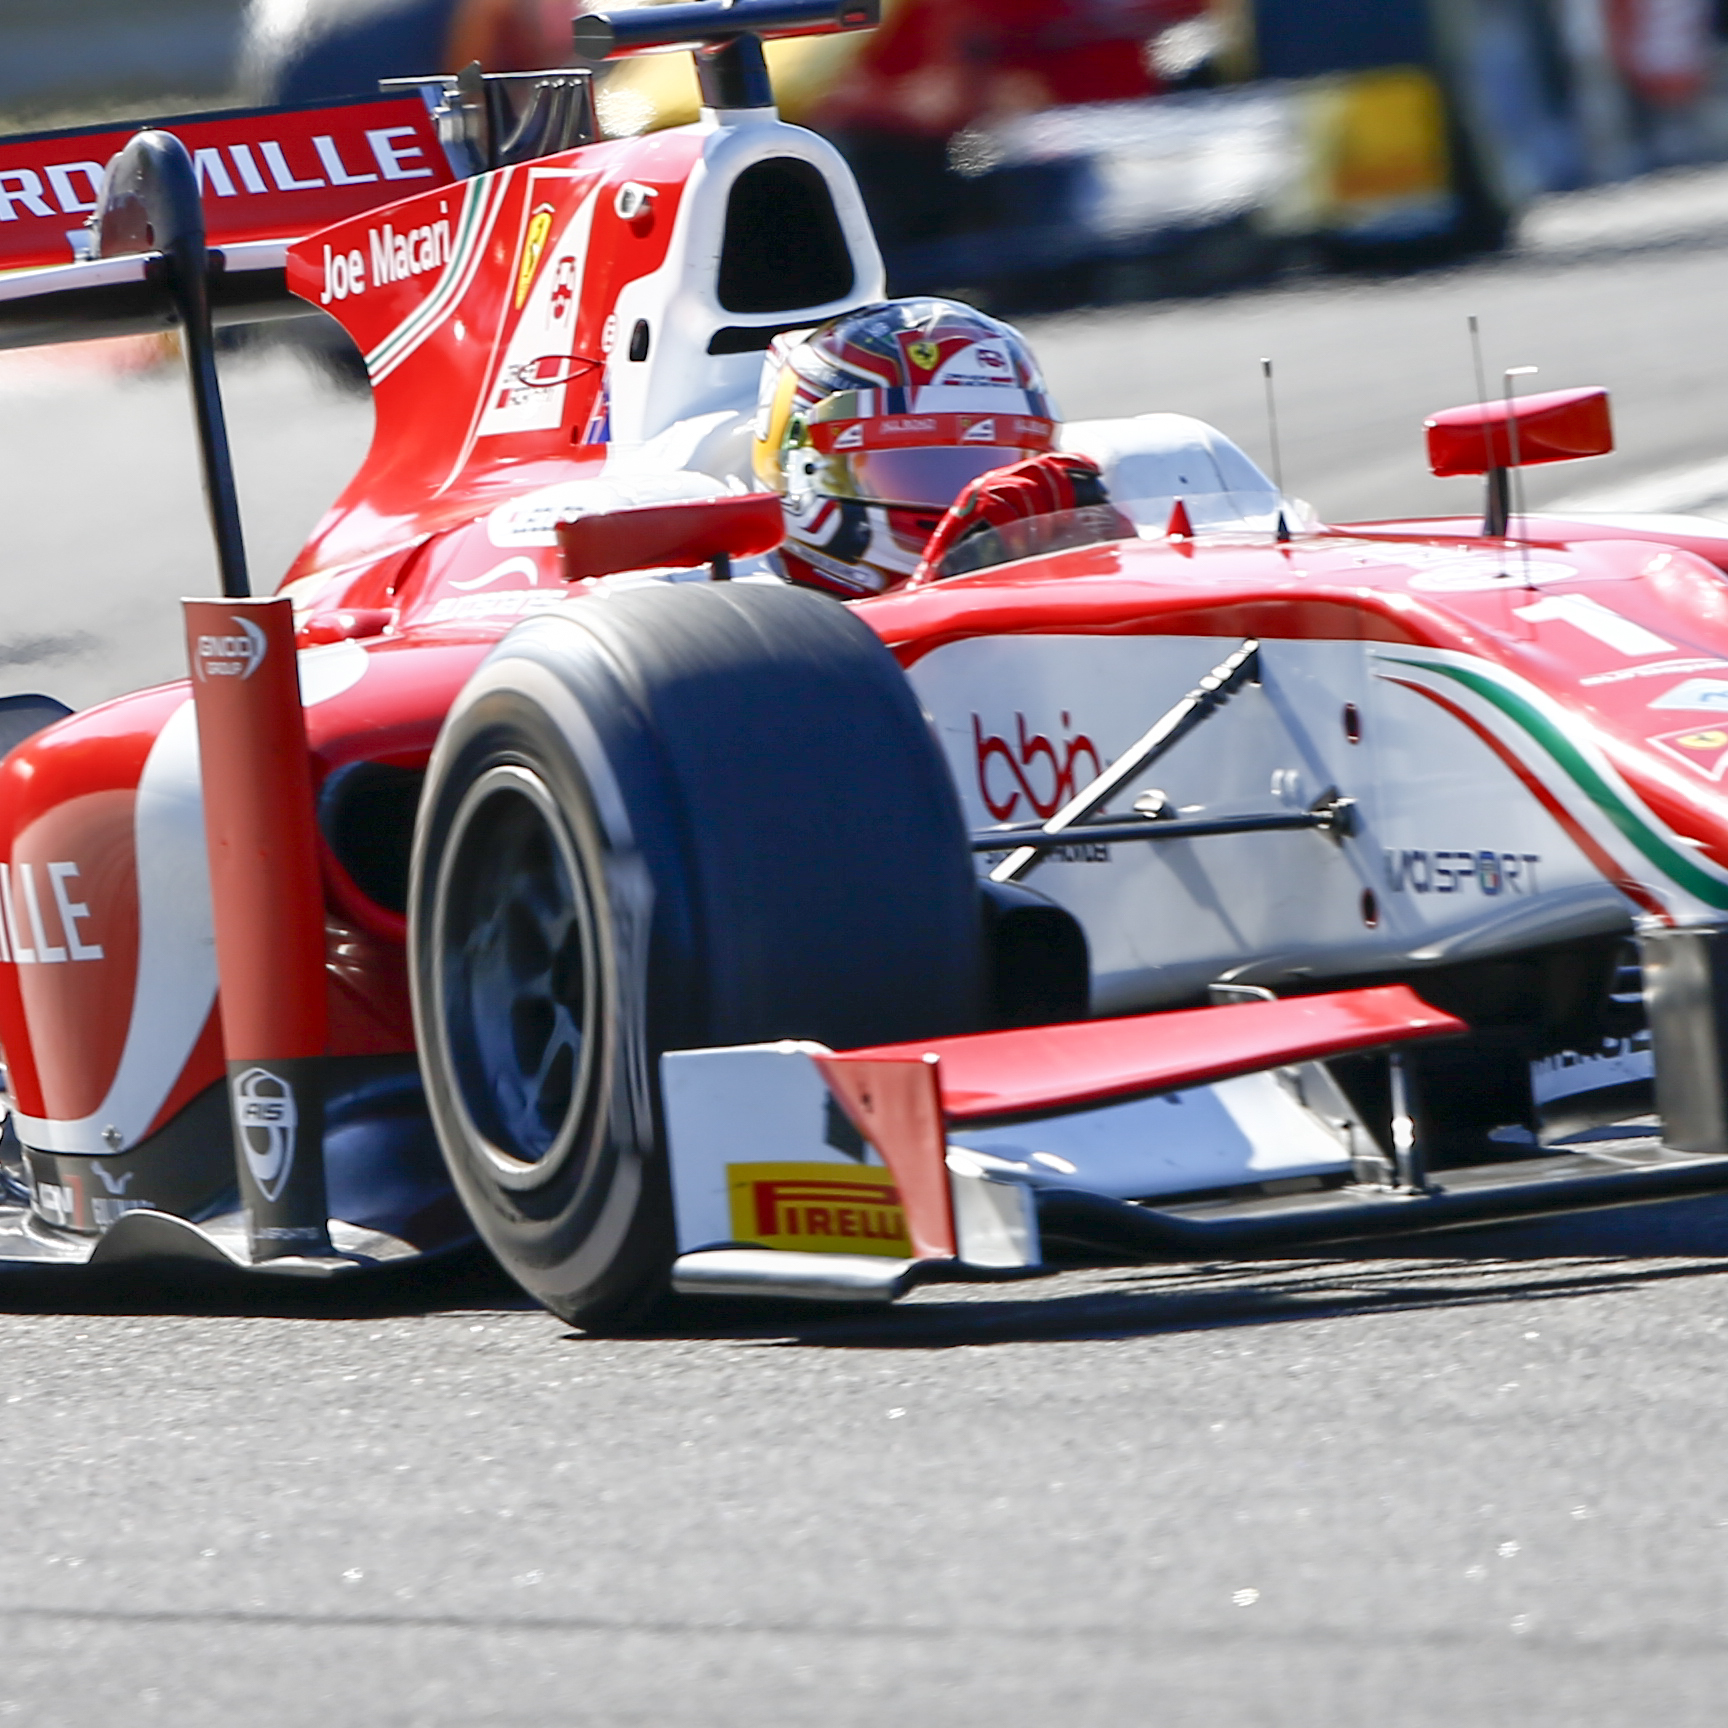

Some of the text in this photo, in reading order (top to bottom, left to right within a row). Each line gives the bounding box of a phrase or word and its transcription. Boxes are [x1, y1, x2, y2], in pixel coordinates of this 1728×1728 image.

[321, 200, 451, 305] Joe Macari
[1511, 593, 1679, 656] 1
